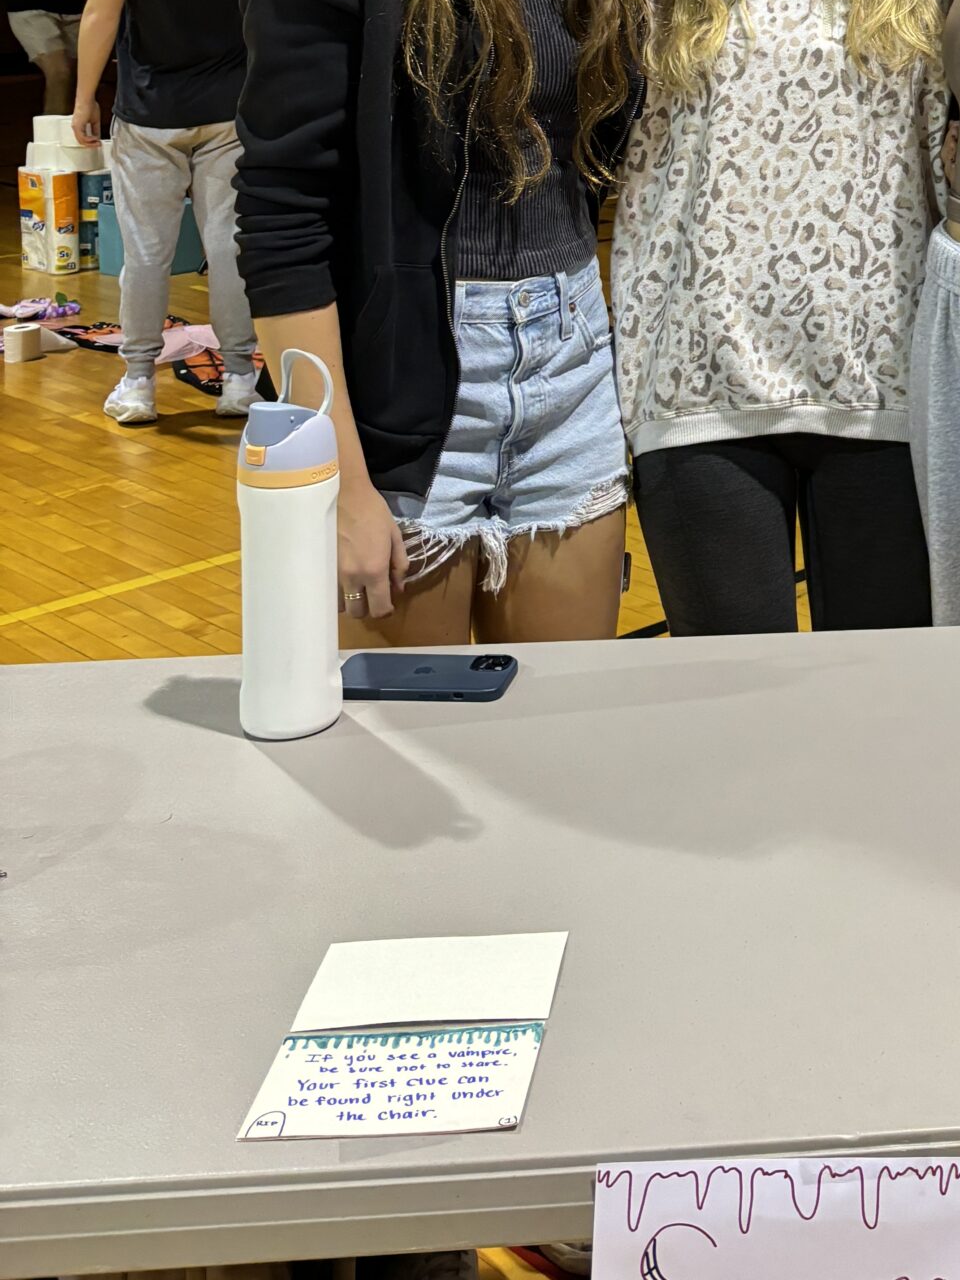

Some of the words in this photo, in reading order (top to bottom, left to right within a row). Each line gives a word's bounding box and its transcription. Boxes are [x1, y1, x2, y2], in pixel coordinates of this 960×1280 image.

[305, 1053, 334, 1063] If
[344, 1054, 376, 1066] you
[386, 1053, 420, 1061] see
[448, 1048, 517, 1059] vampire,
[319, 1066, 339, 1074] be
[349, 1066, 384, 1074] sure
[396, 1064, 427, 1072] not
[461, 1060, 508, 1068] stare.
[297, 1079, 340, 1092] Your
[352, 1078, 397, 1089] first
[457, 1075, 490, 1085] can
[288, 1096, 309, 1107] be
[315, 1093, 371, 1106] found
[387, 1092, 437, 1107] right
[451, 1088, 504, 1100] under
[336, 1111, 367, 1121] the
